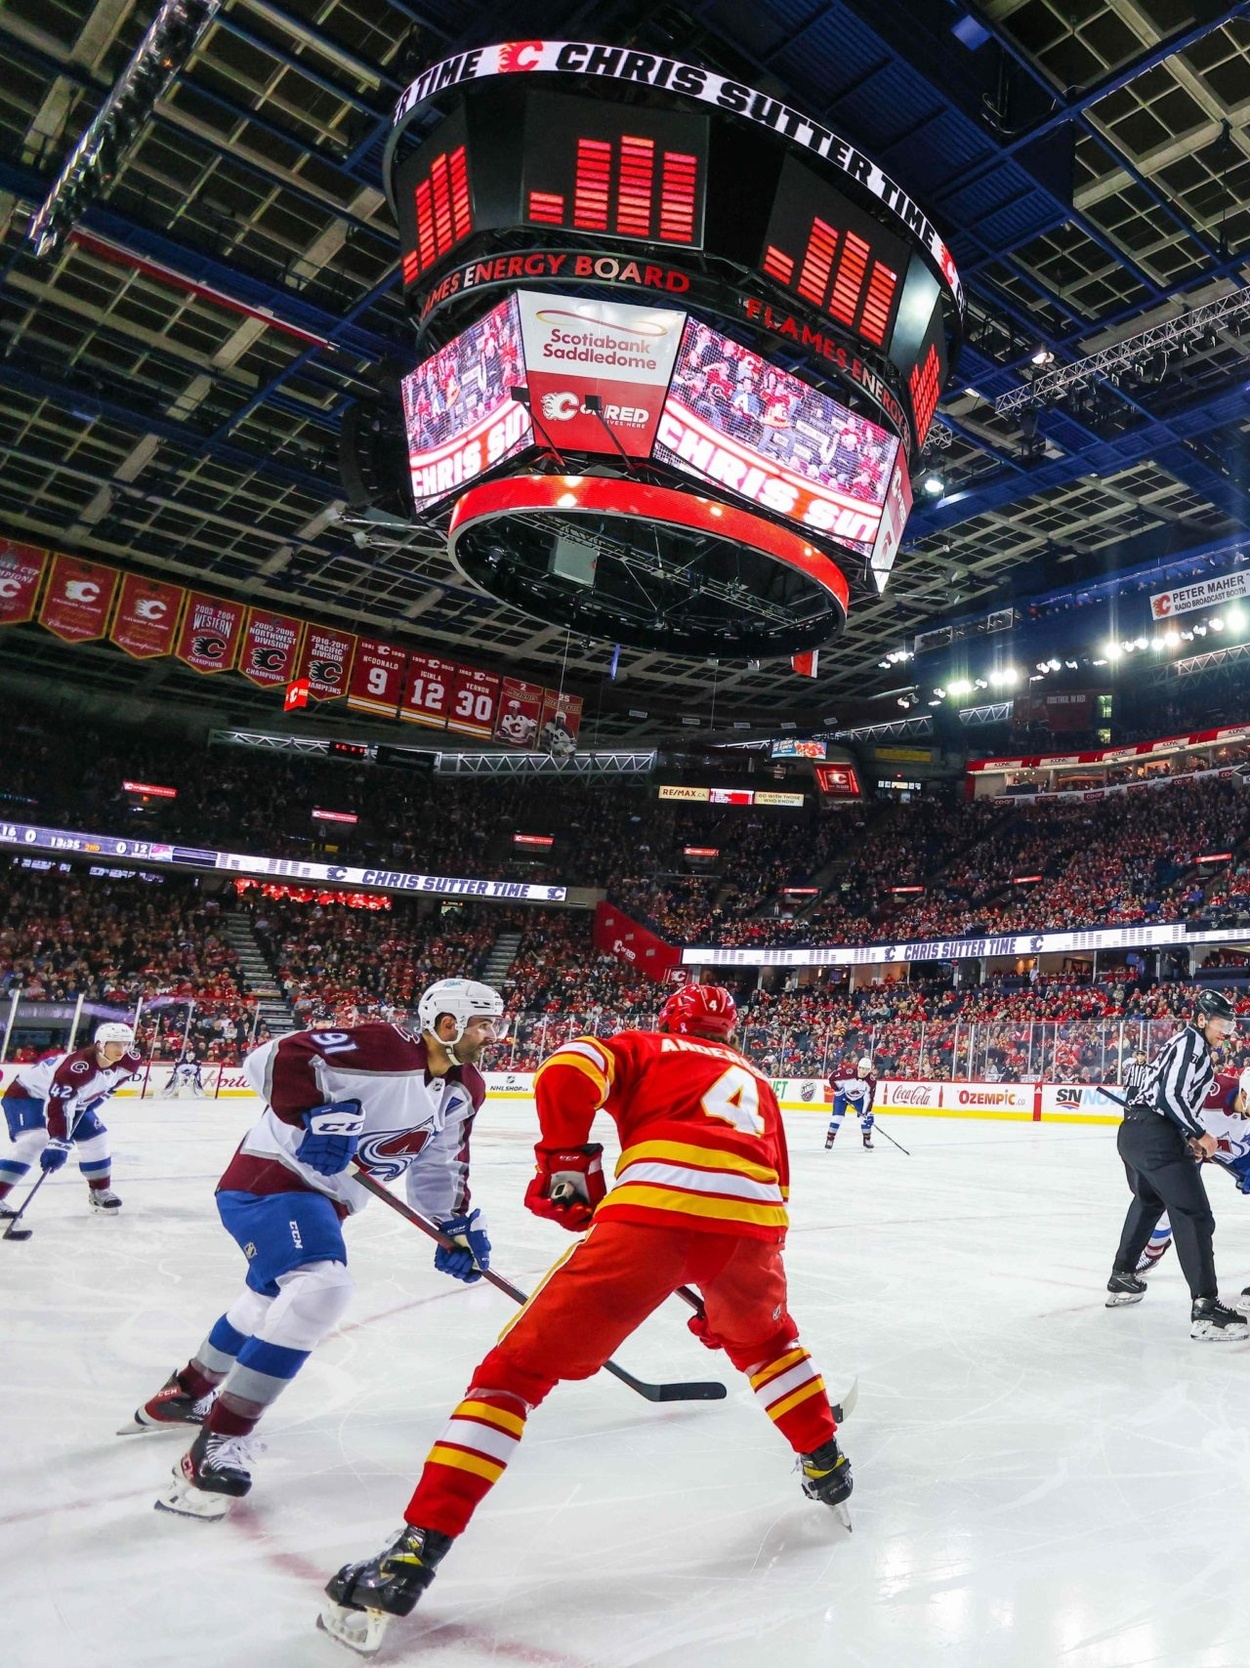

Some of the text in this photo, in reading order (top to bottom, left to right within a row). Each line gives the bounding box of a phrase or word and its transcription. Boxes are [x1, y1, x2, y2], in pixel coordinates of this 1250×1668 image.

[415, 49, 484, 100] TIME
[556, 43, 935, 251] CHRIS SUTTER TIME
[463, 253, 568, 289] ENERGY
[574, 255, 691, 294] BOARD
[551, 328, 652, 355] Scotiabank
[746, 297, 847, 370] FLAMES
[543, 343, 658, 371] Saddledome
[604, 404, 650, 423] RED
[412, 439, 482, 498] CHRIS
[656, 412, 799, 514] CHRIS
[1172, 575, 1245, 603] PETER MAHER
[1174, 586, 1247, 612] RADIO BROADCAST BOOTH
[192, 613, 232, 640] WESTERN
[249, 627, 297, 646] NORTHWEST
[253, 636, 290, 651] DIVISION
[366, 667, 388, 696] 9
[410, 678, 445, 710] 12
[454, 690, 493, 722] 30
[25, 829, 36, 843] 0
[116, 841, 127, 854] 0
[362, 870, 531, 899] CHRIS SUTTER TIME
[904, 937, 1017, 960] CHRIS SUTTER TIME
[708, 999, 718, 1012] 4
[310, 1031, 358, 1056] 91
[50, 1083, 73, 1099] 42
[701, 1065, 765, 1139] 4
[1056, 1088, 1082, 1103] SN
[289, 1220, 303, 1250] CCM
[158, 1388, 178, 1397] CCM
